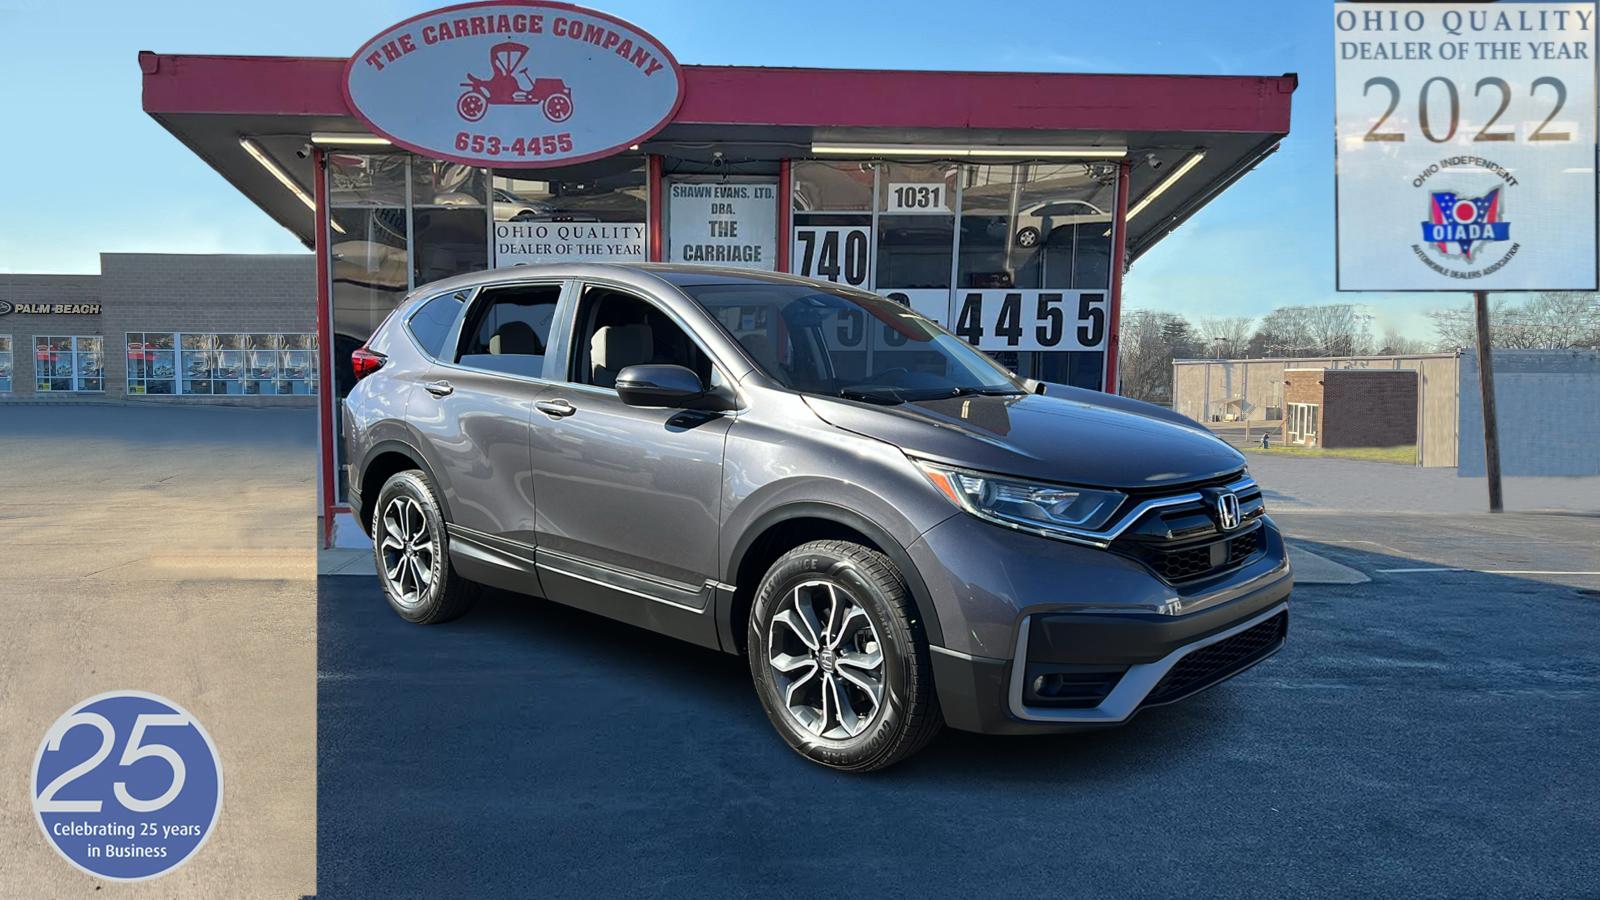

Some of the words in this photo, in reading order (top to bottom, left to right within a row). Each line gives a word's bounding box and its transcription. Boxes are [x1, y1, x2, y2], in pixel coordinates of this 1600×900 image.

[1336, 10, 1424, 31] OHIO
[1442, 10, 1592, 35] QUALITY
[365, 34, 417, 72] THE
[422, 14, 543, 45] CARRIAGE
[552, 17, 665, 77] COMPANY
[1340, 42, 1433, 60] DEALER
[1439, 42, 1469, 60] OF
[1475, 42, 1521, 60] THE
[1528, 42, 1589, 60] YEAR
[1363, 76, 1570, 143] 2022
[454, 132, 573, 156] 653-4455
[1412, 164, 1439, 188] OHIO
[1440, 156, 1519, 187] INDEPENDENT
[673, 186, 711, 198] SHAWN
[754, 188, 774, 199] LTD.
[895, 187, 940, 208] 1031
[711, 204, 735, 215] DBA.
[497, 226, 548, 238] OHIO
[558, 226, 643, 241] QUALITY
[709, 221, 737, 237] THE
[1433, 224, 1495, 240] OIADA
[500, 244, 551, 254] DEALER
[555, 244, 574, 254] OF
[576, 244, 602, 254] THE
[606, 245, 641, 255] YEAR
[683, 245, 762, 262] CARRIAGE
[797, 230, 868, 286] 740
[1411, 244, 1449, 276] AUTOMOBILE
[1450, 269, 1482, 279] DEALERS
[15, 304, 50, 313] PALM
[55, 304, 99, 314] BEACH
